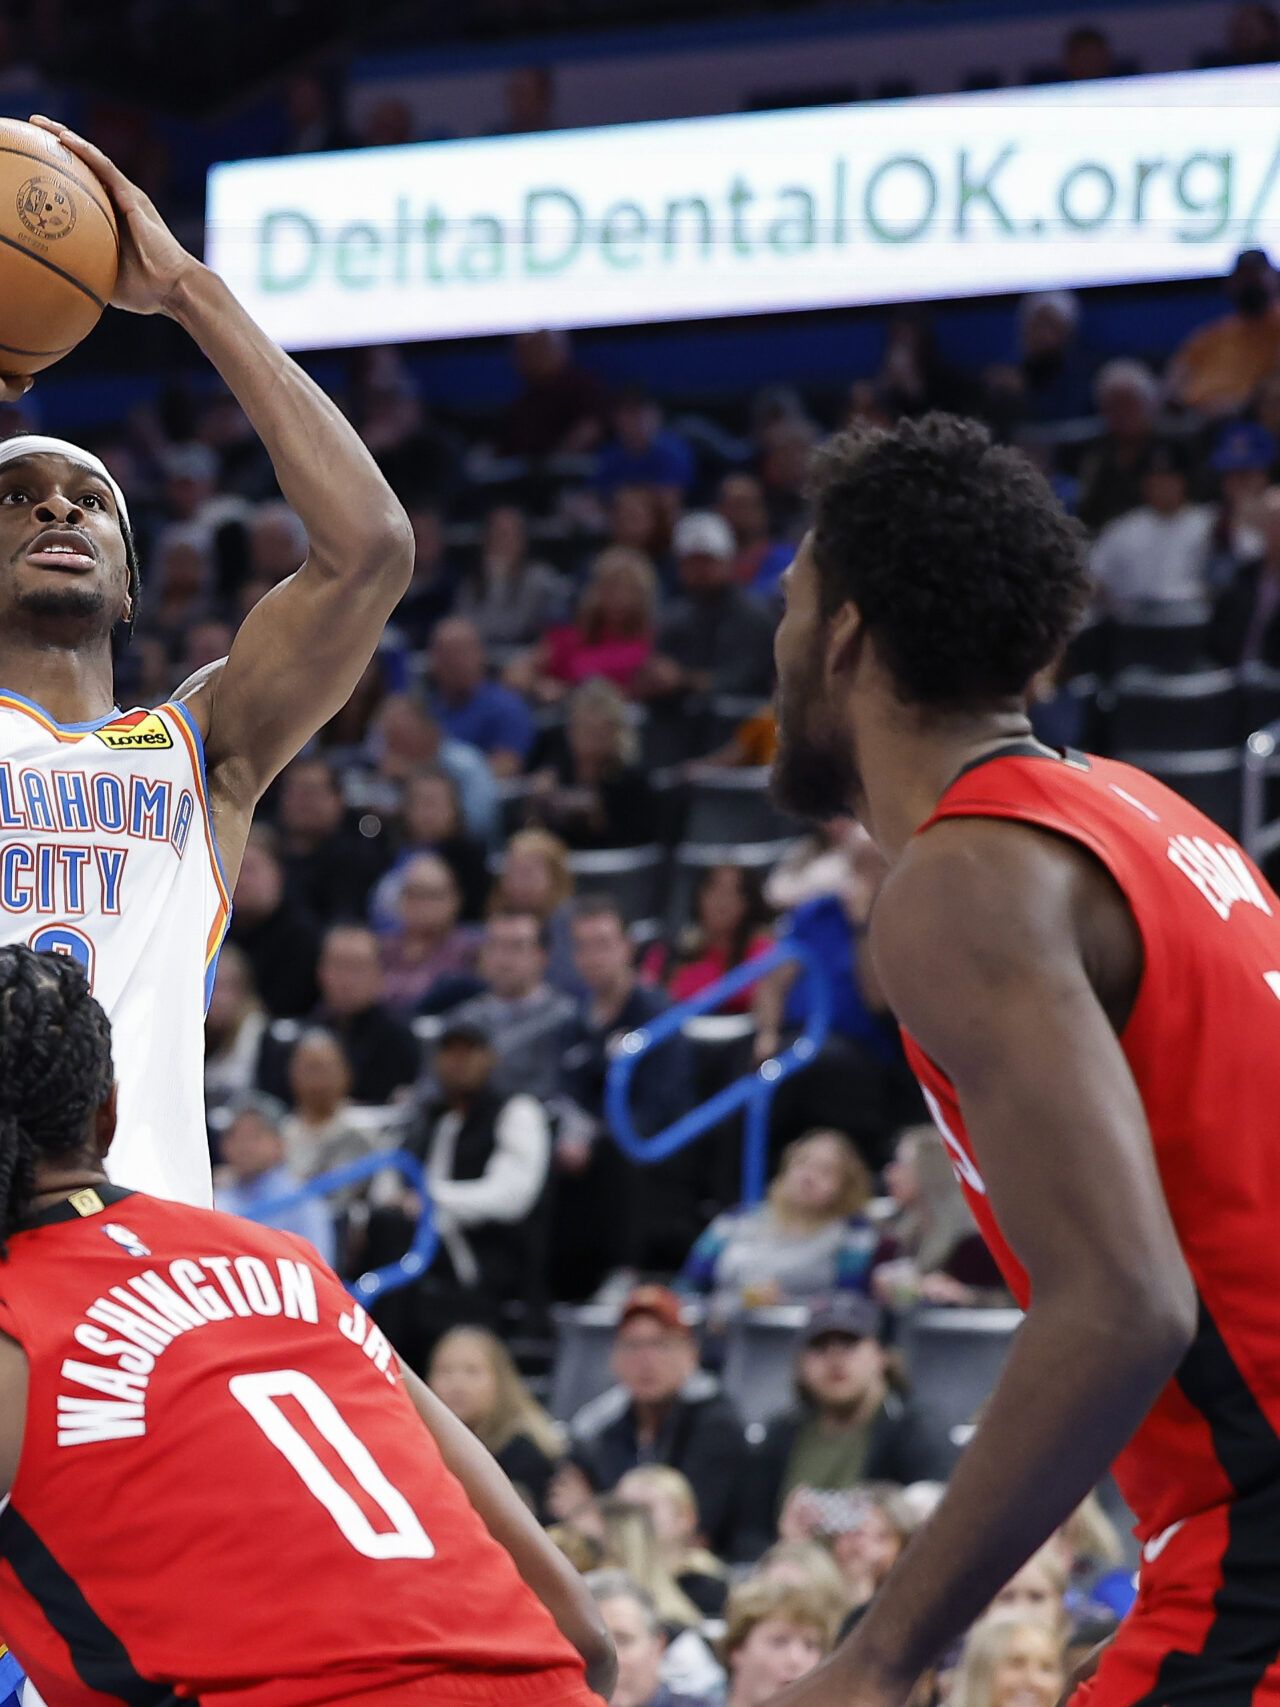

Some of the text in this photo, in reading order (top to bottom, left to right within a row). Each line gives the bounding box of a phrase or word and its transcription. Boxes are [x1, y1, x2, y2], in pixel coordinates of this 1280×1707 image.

[0, 843, 128, 914] CITY
[57, 1256, 318, 1447] WASHINGTON
[228, 1369, 435, 1559] 0
